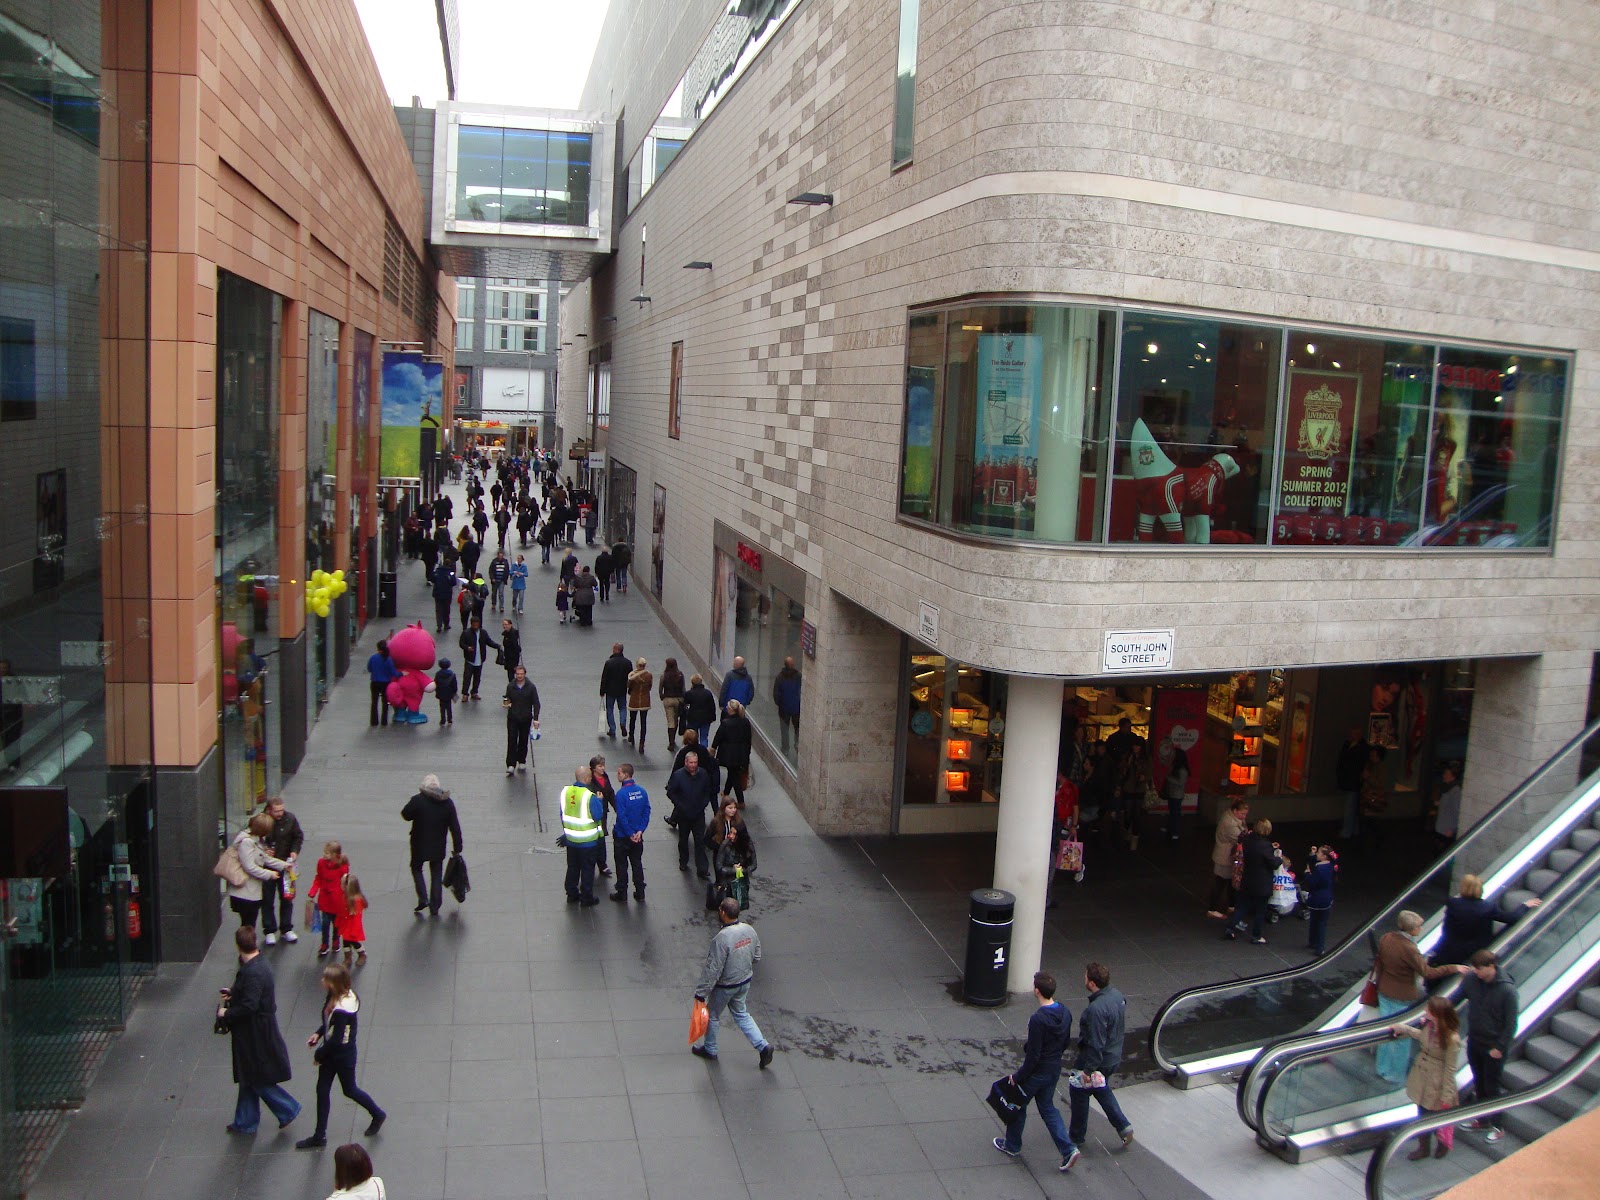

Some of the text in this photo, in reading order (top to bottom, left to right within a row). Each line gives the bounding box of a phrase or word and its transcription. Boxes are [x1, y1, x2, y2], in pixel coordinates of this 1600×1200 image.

[1308, 411, 1335, 419] LIVERPOOL
[1300, 466, 1333, 478] SPRING
[1282, 480, 1347, 494] SUMMER 2012
[1284, 495, 1342, 507] COLLECTIONS
[1278, 525, 1286, 538] 9
[1326, 528, 1335, 539] 9
[1373, 526, 1381, 539] 9
[1110, 643, 1167, 653] SOUTH JOHN
[1121, 654, 1156, 663] STREET
[994, 947, 1005, 963] 1
